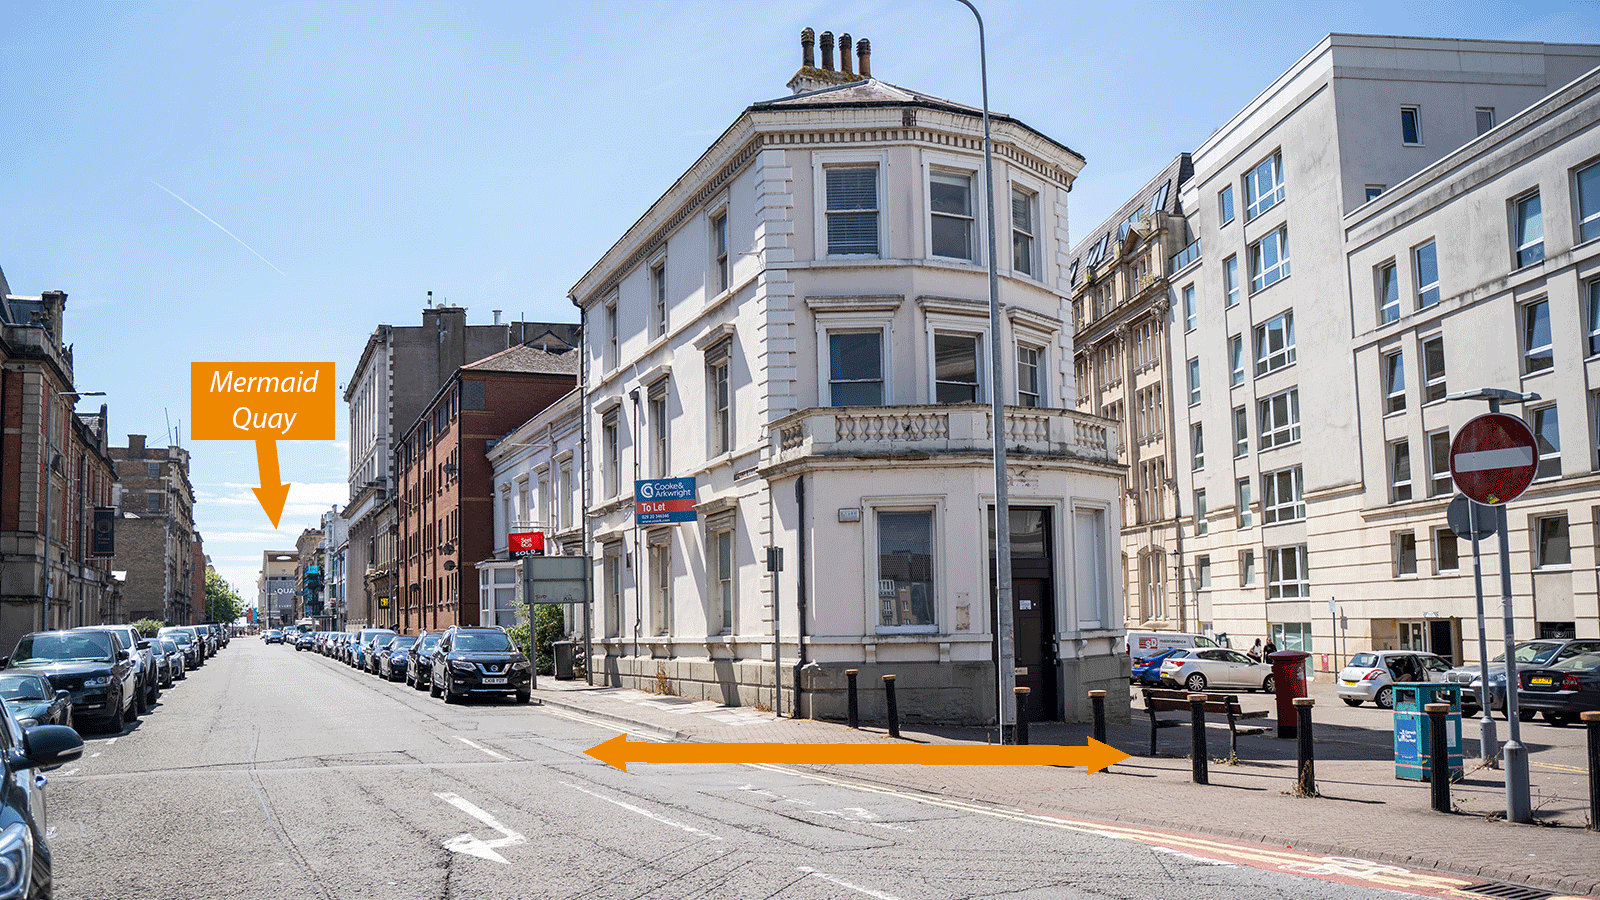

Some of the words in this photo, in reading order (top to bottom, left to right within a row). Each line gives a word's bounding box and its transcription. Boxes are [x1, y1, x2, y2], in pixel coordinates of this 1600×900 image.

[654, 482, 684, 490] Cooke&
[655, 489, 691, 498] Arkwright
[641, 503, 651, 512] To
[653, 502, 665, 512] Let
[277, 587, 295, 595] QUA
